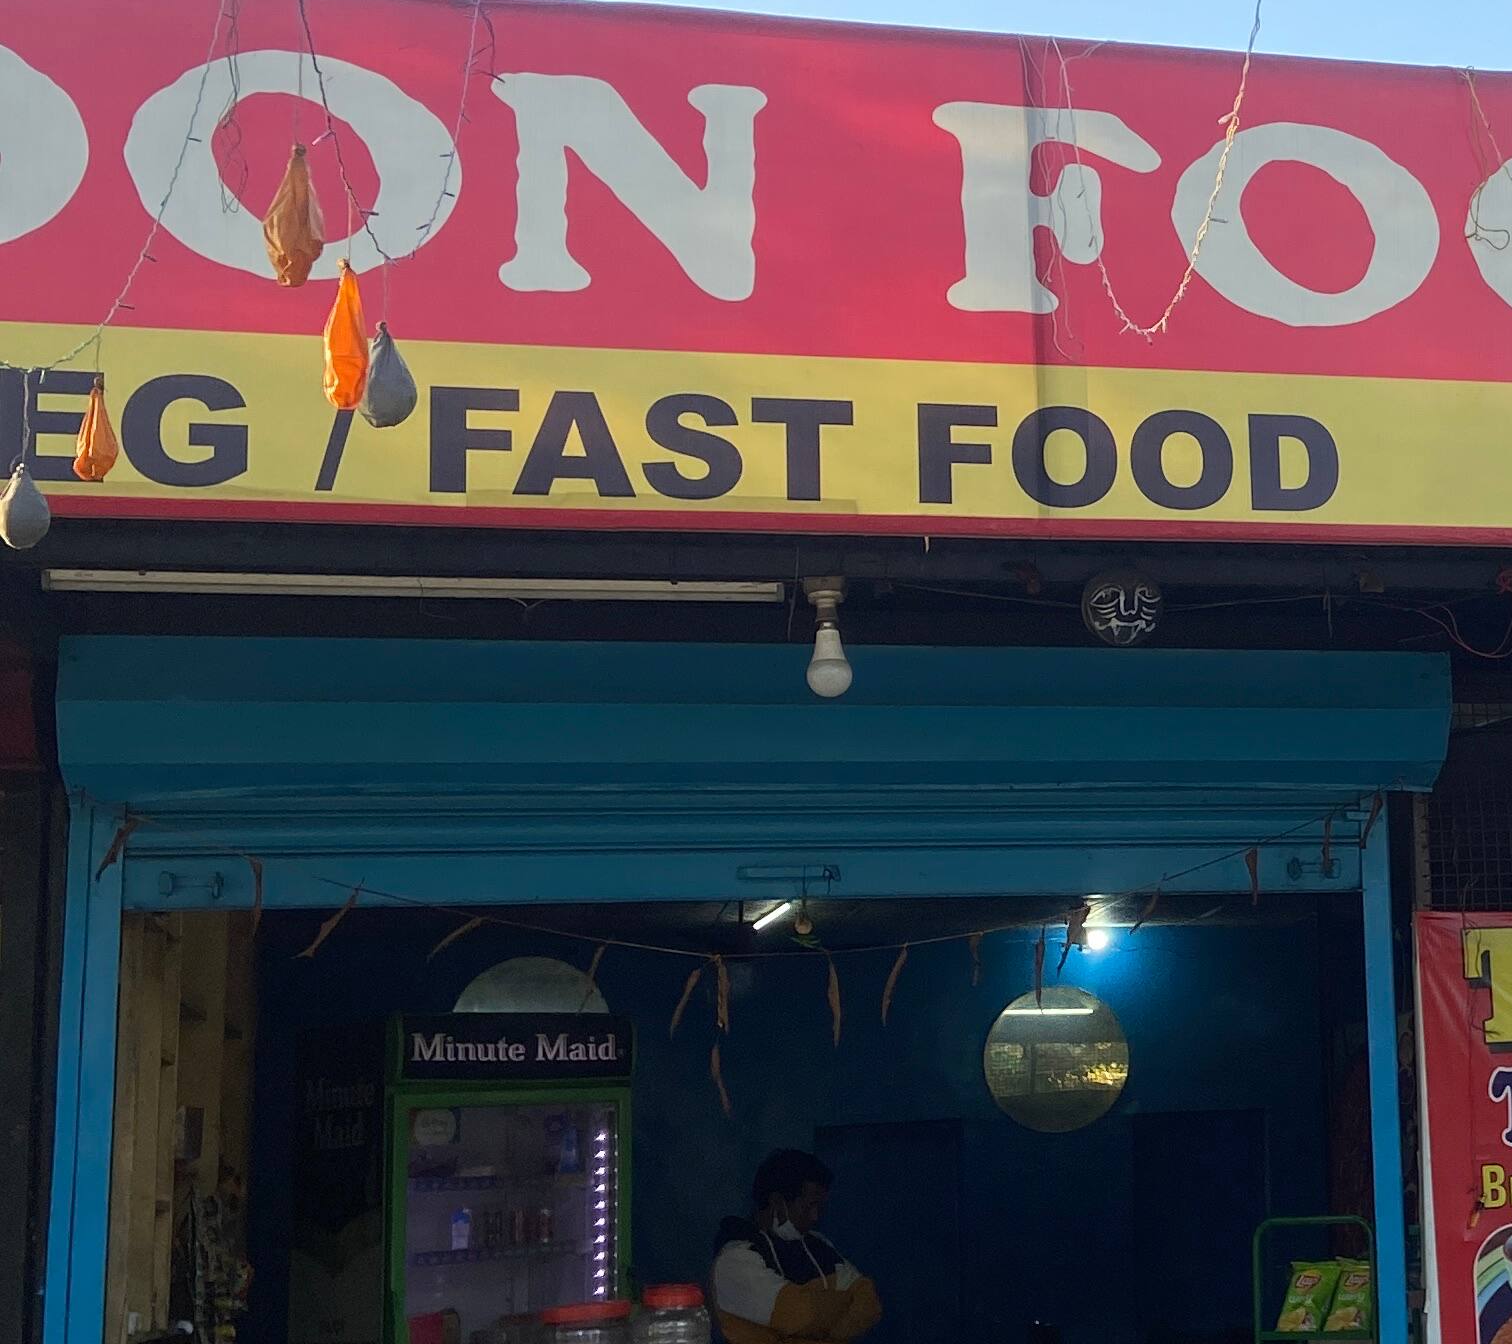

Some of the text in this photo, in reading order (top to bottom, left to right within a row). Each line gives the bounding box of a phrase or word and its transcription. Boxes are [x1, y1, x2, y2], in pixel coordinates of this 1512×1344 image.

[0, 46, 768, 302] ON
[429, 386, 855, 502] FAST
[916, 402, 1340, 512] FOOD
[411, 1032, 618, 1062] Minute Maid
